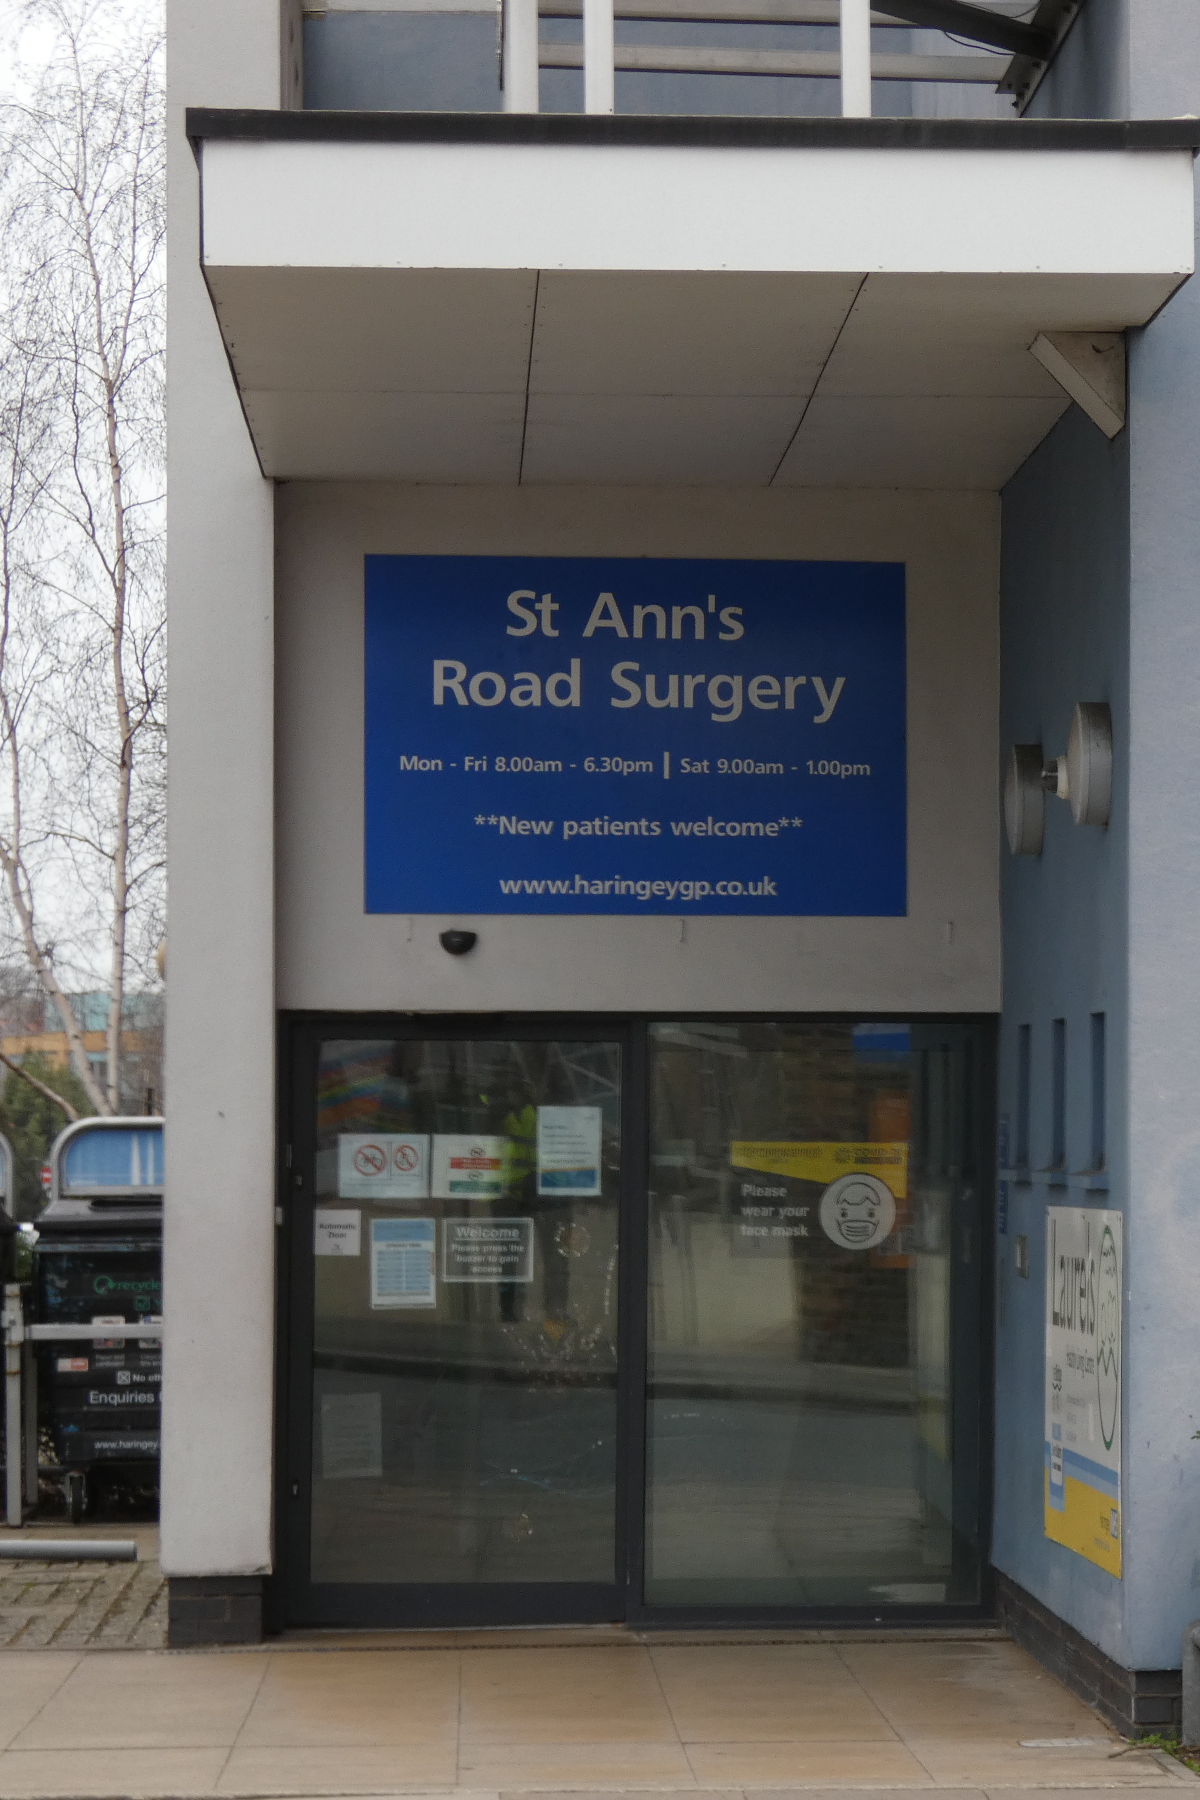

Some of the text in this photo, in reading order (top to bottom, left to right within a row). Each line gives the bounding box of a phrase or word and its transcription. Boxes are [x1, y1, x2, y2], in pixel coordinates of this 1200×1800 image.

[507, 590, 744, 640] St Ann's
[433, 658, 845, 723] Road Surgery
[400, 756, 442, 771] Mon
[465, 756, 487, 771] Fri
[495, 757, 562, 772] 8.00am
[584, 757, 653, 776] 6.30pm
[681, 758, 709, 773] Sat
[717, 759, 784, 774] 9.00am
[807, 760, 870, 779] 1.00pm
[564, 816, 661, 840] patients
[499, 874, 777, 900] www.haringeygp.co.uk
[741, 1184, 787, 1197] Please
[741, 1206, 810, 1219] wear your
[456, 1227, 520, 1238] Welcome
[740, 1224, 809, 1236] face mask
[1053, 1219, 1095, 1337] Laurels
[132, 1374, 146, 1382] No
[89, 1390, 155, 1406] Enquiries
